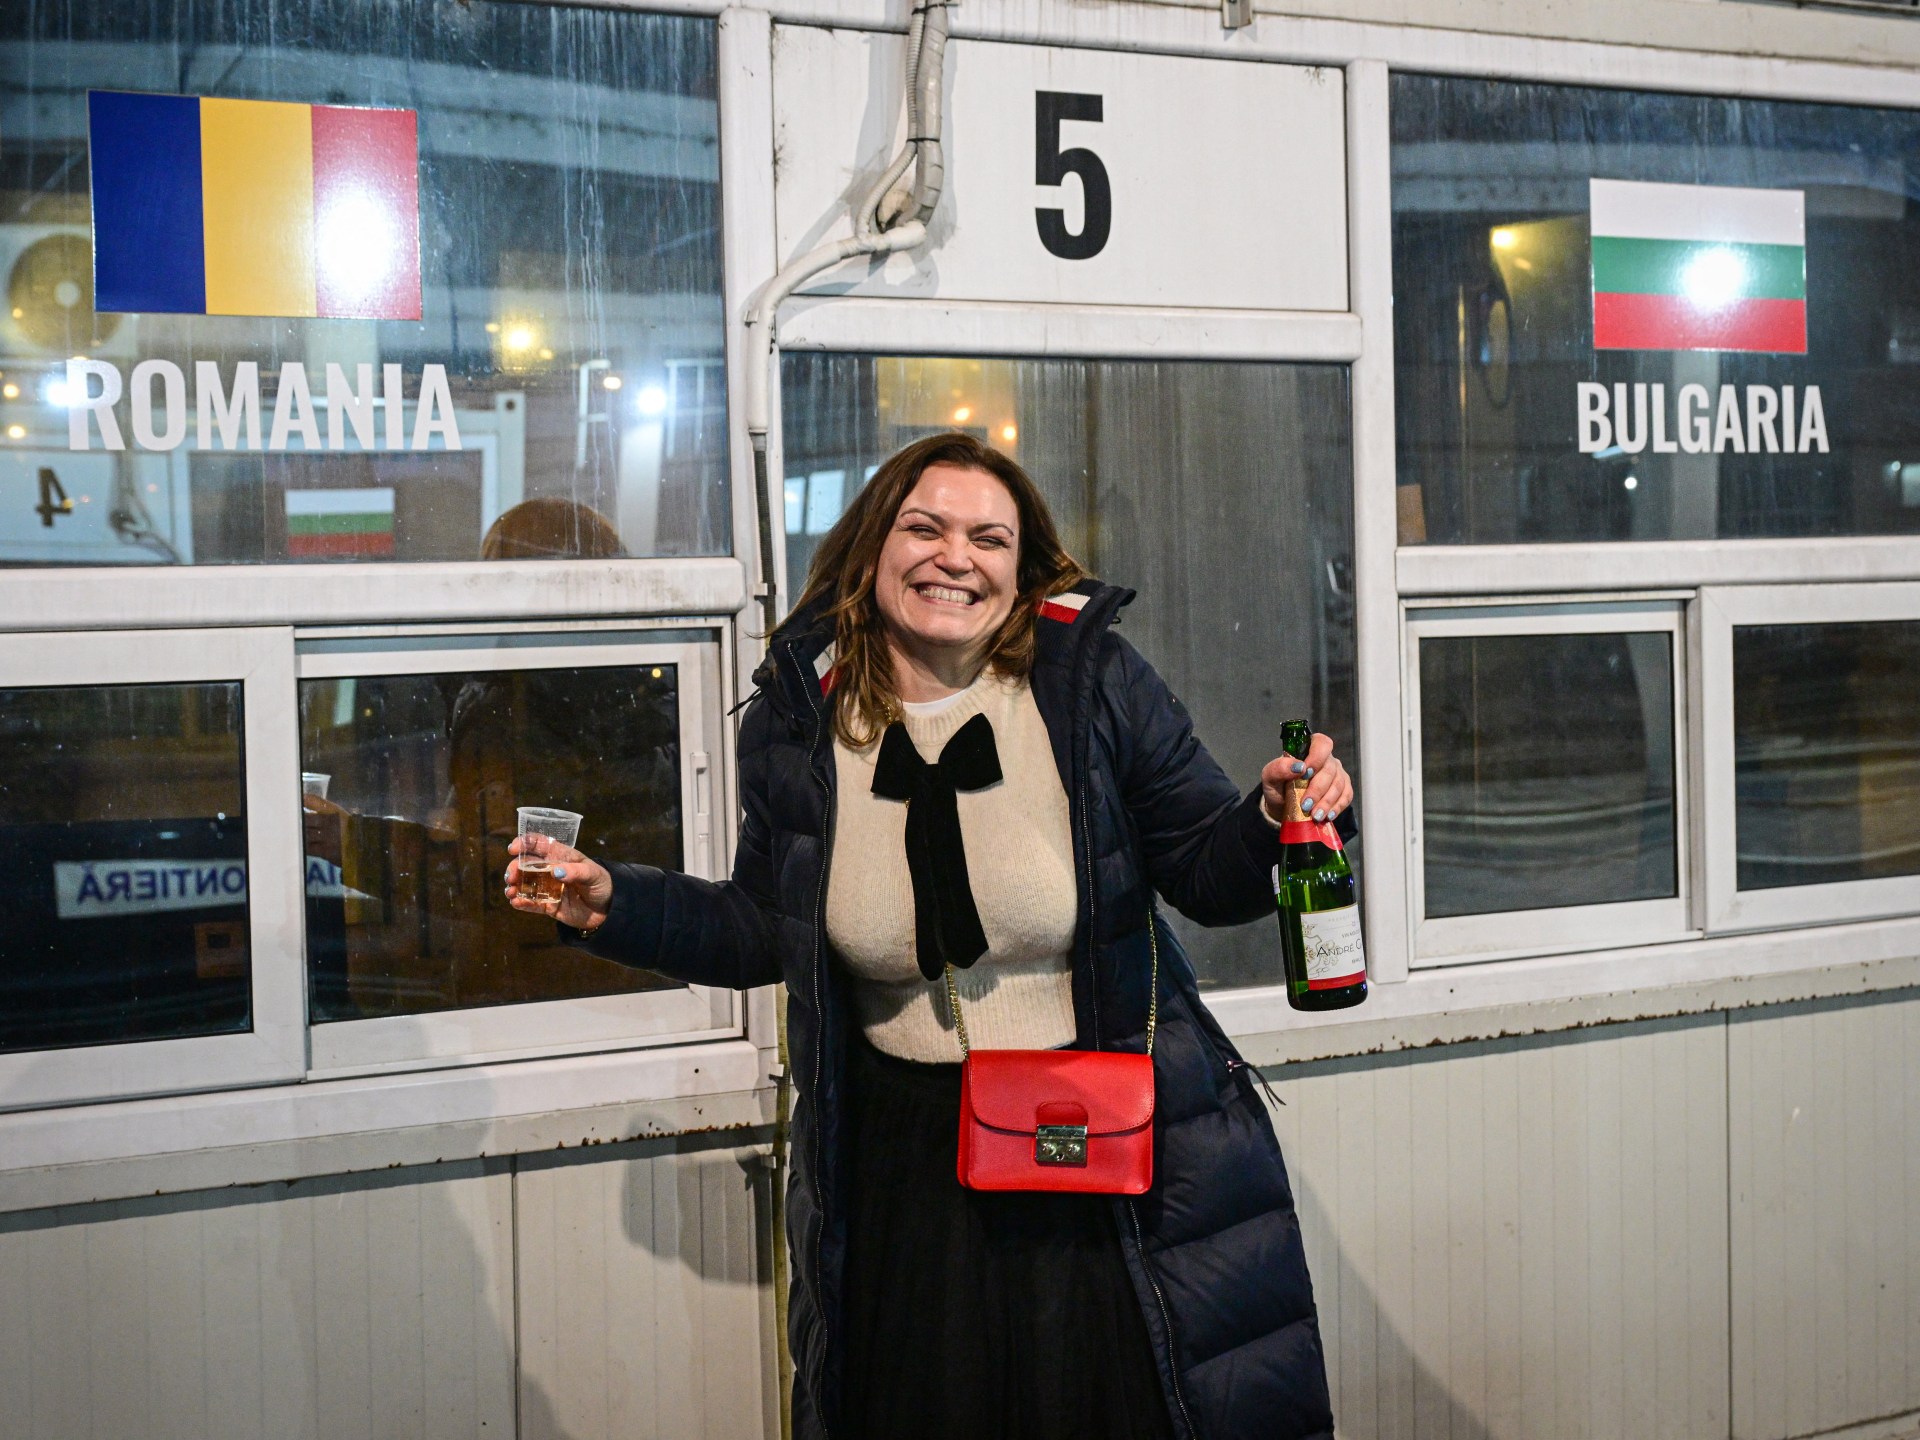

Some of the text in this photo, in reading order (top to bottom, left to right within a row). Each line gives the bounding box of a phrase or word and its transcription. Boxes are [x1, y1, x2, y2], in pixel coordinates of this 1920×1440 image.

[1035, 90, 1112, 260] 5
[66, 358, 463, 452] ROMANIA
[1577, 381, 1830, 454] BULGARIA
